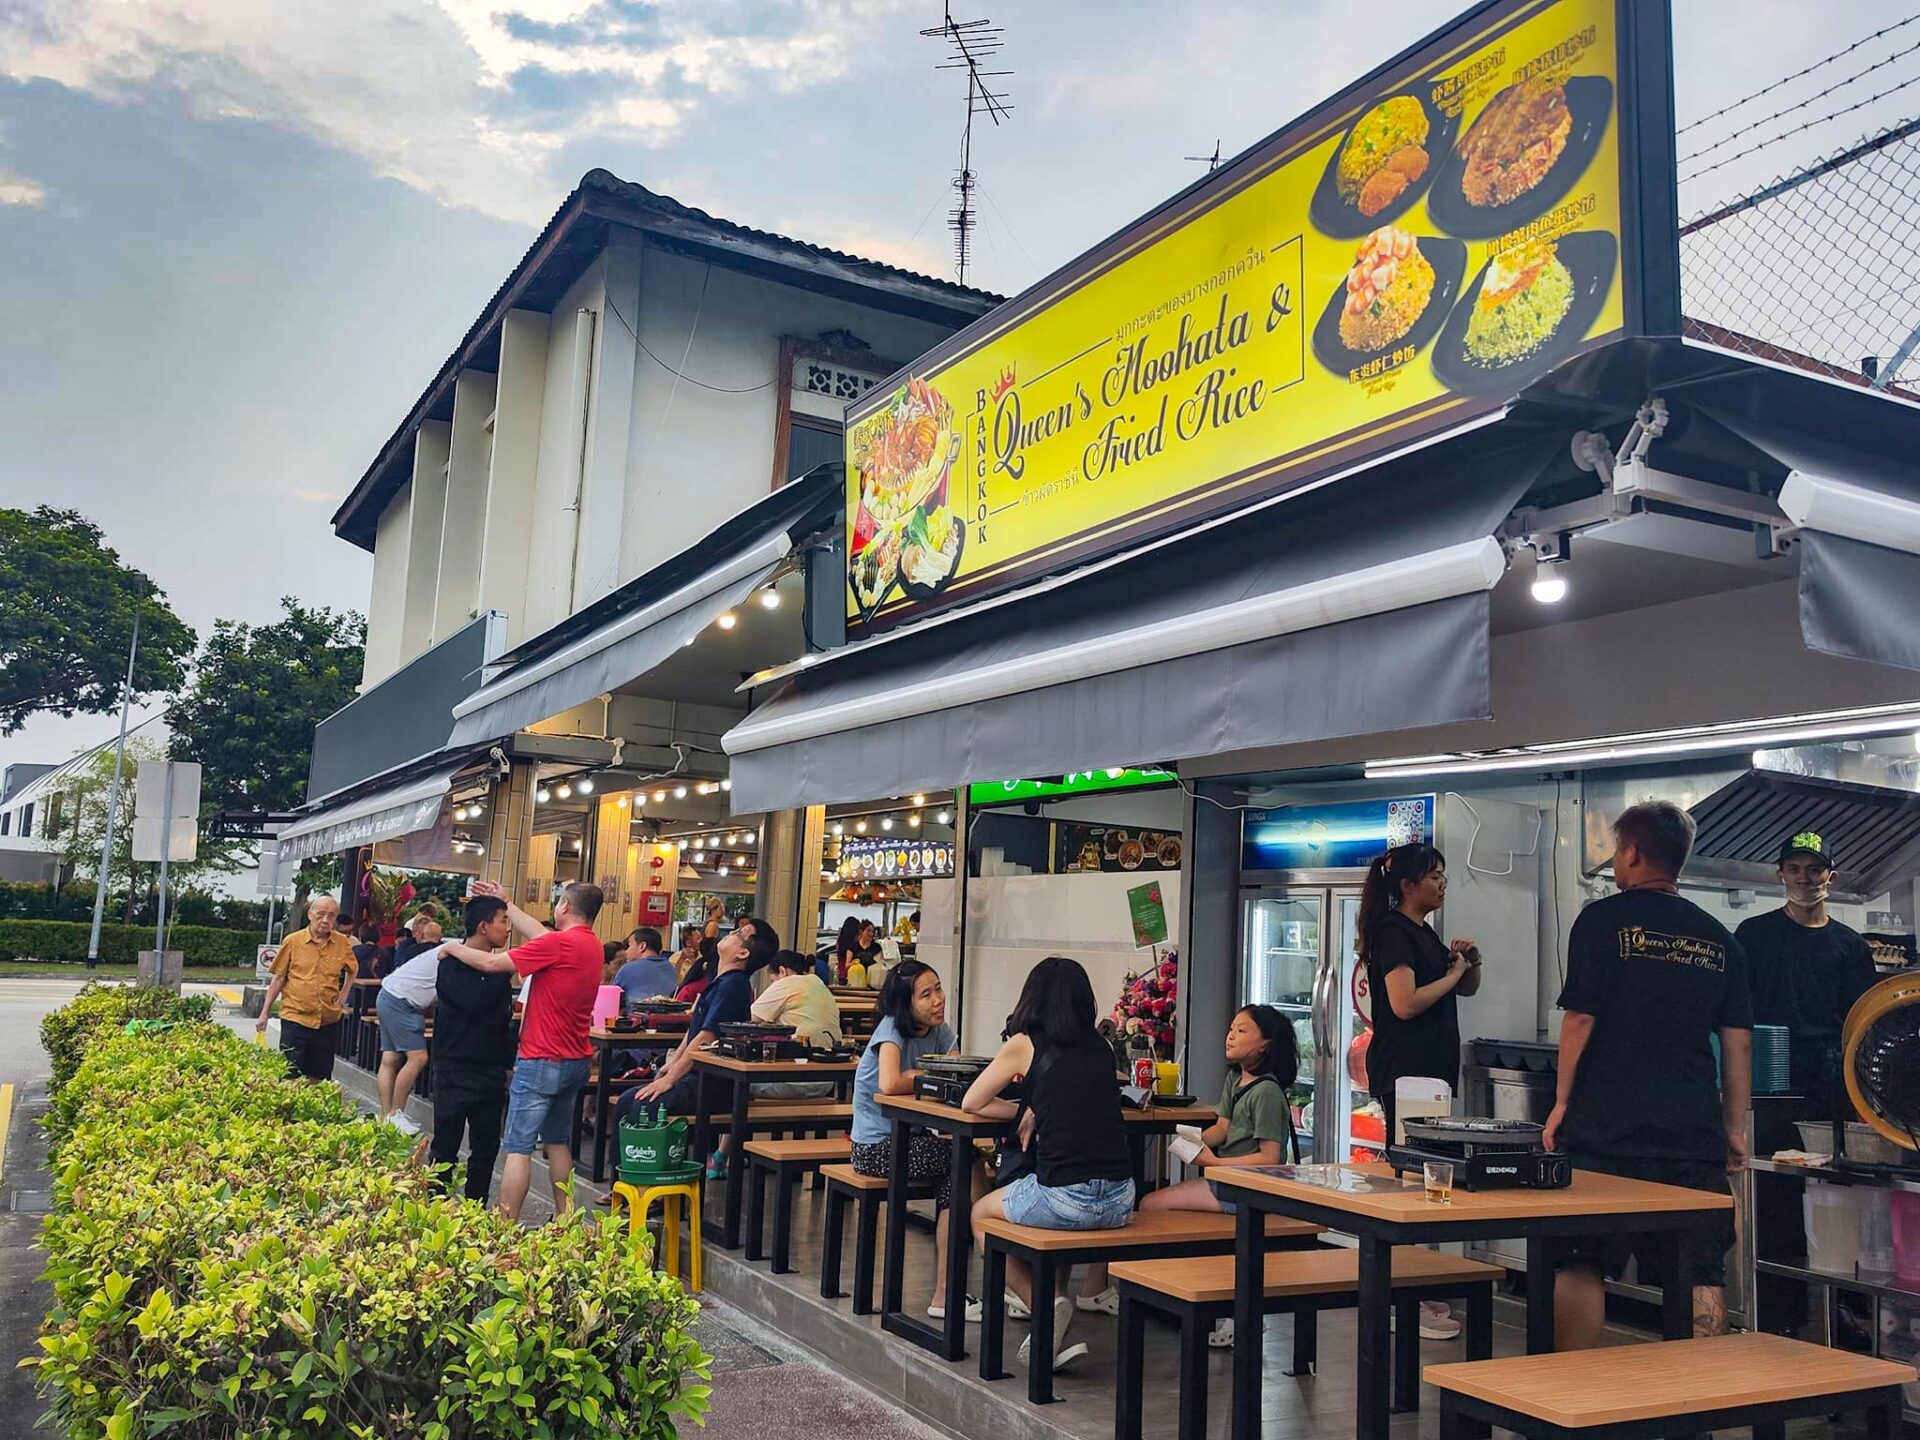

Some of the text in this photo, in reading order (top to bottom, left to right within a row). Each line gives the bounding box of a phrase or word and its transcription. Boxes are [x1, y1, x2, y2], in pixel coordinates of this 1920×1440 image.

[993, 382, 1095, 480] Queen's
[1266, 282, 1293, 333] &
[1083, 367, 1267, 481] Fried Rice
[975, 388, 988, 544] BANGKOK
[1102, 1025, 1110, 1037] 2
[625, 1145, 657, 1159] Carlsberg
